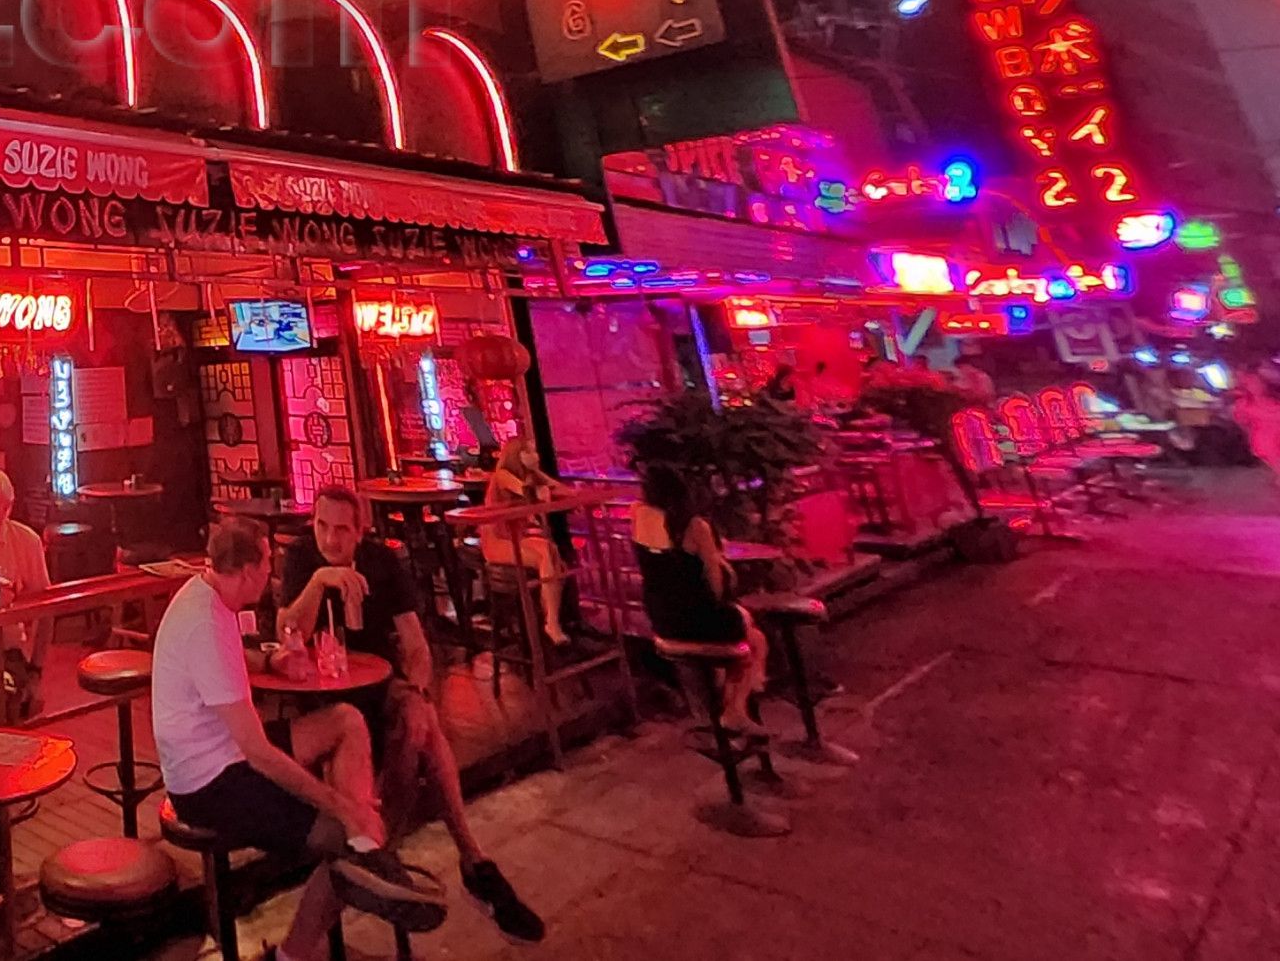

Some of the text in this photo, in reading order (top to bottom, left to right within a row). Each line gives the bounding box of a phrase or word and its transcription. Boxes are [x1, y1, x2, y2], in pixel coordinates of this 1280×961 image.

[4, 139, 150, 189] SUZIE WONG
[2, 192, 128, 238] WONG
[154, 204, 358, 255] SUZIE WONG
